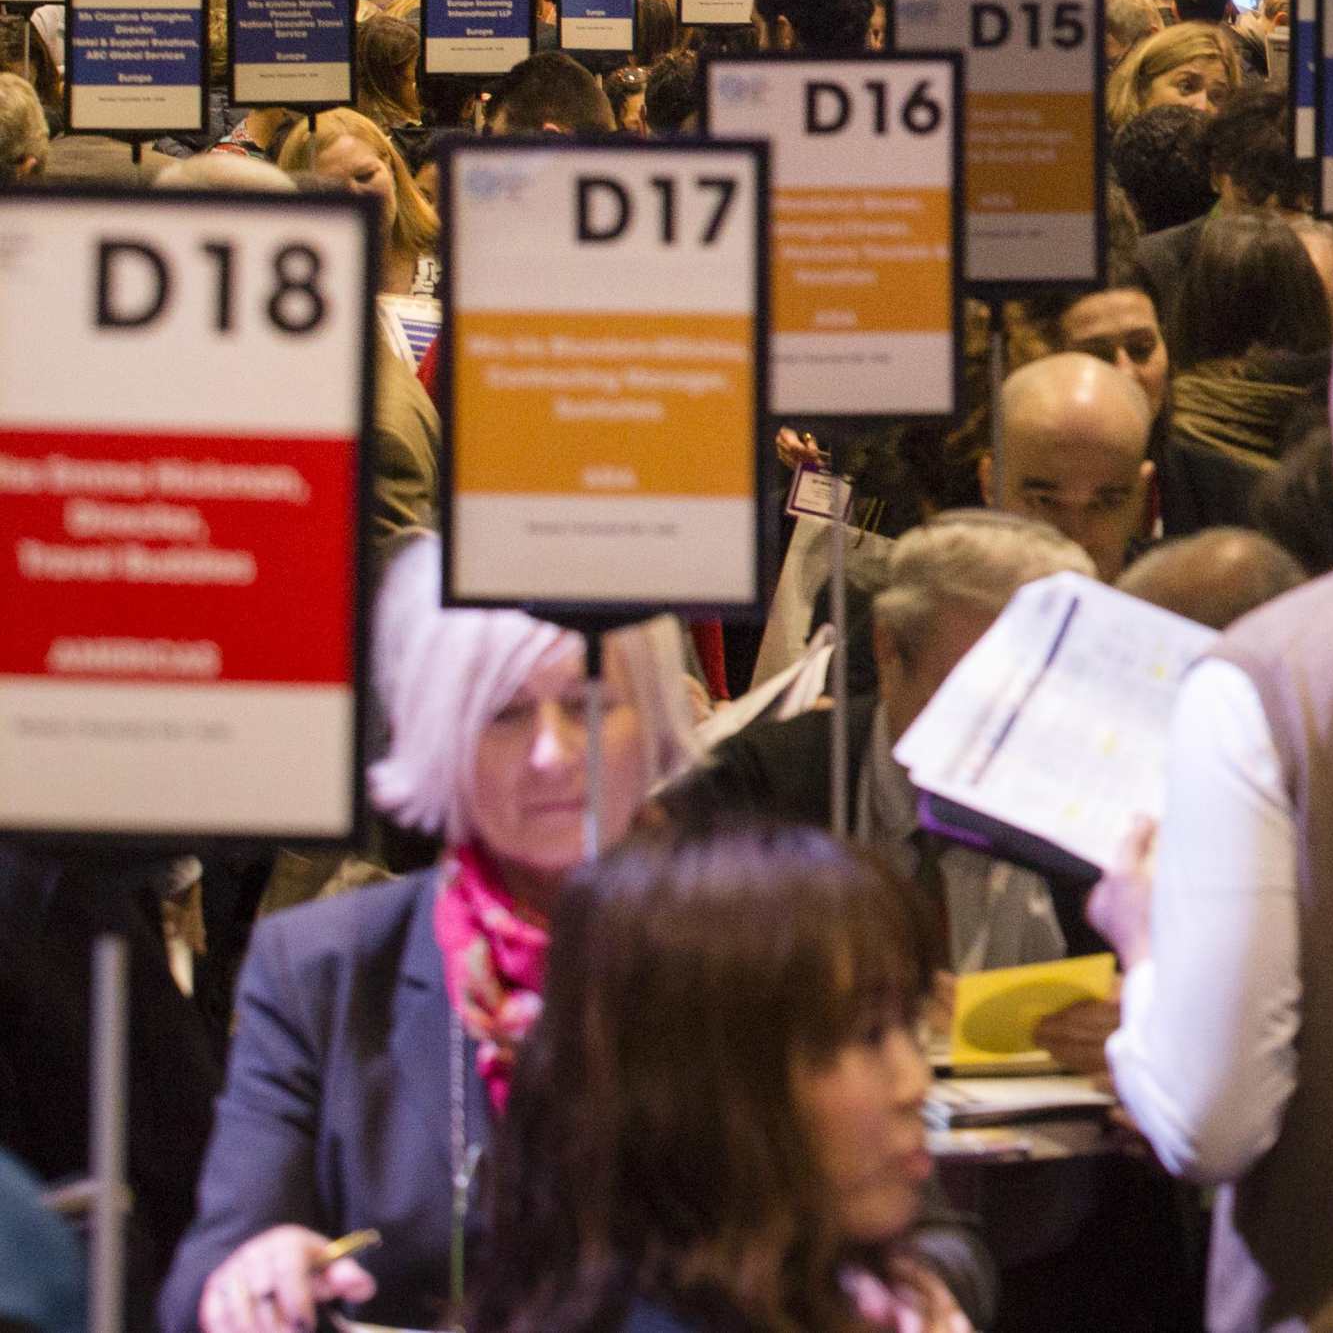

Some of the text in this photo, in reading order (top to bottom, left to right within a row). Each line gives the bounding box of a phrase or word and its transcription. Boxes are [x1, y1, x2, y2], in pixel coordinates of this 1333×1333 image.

[972, 2, 1085, 50] D15
[805, 81, 942, 136] D16
[576, 176, 737, 244] D17
[96, 239, 325, 335] D18
